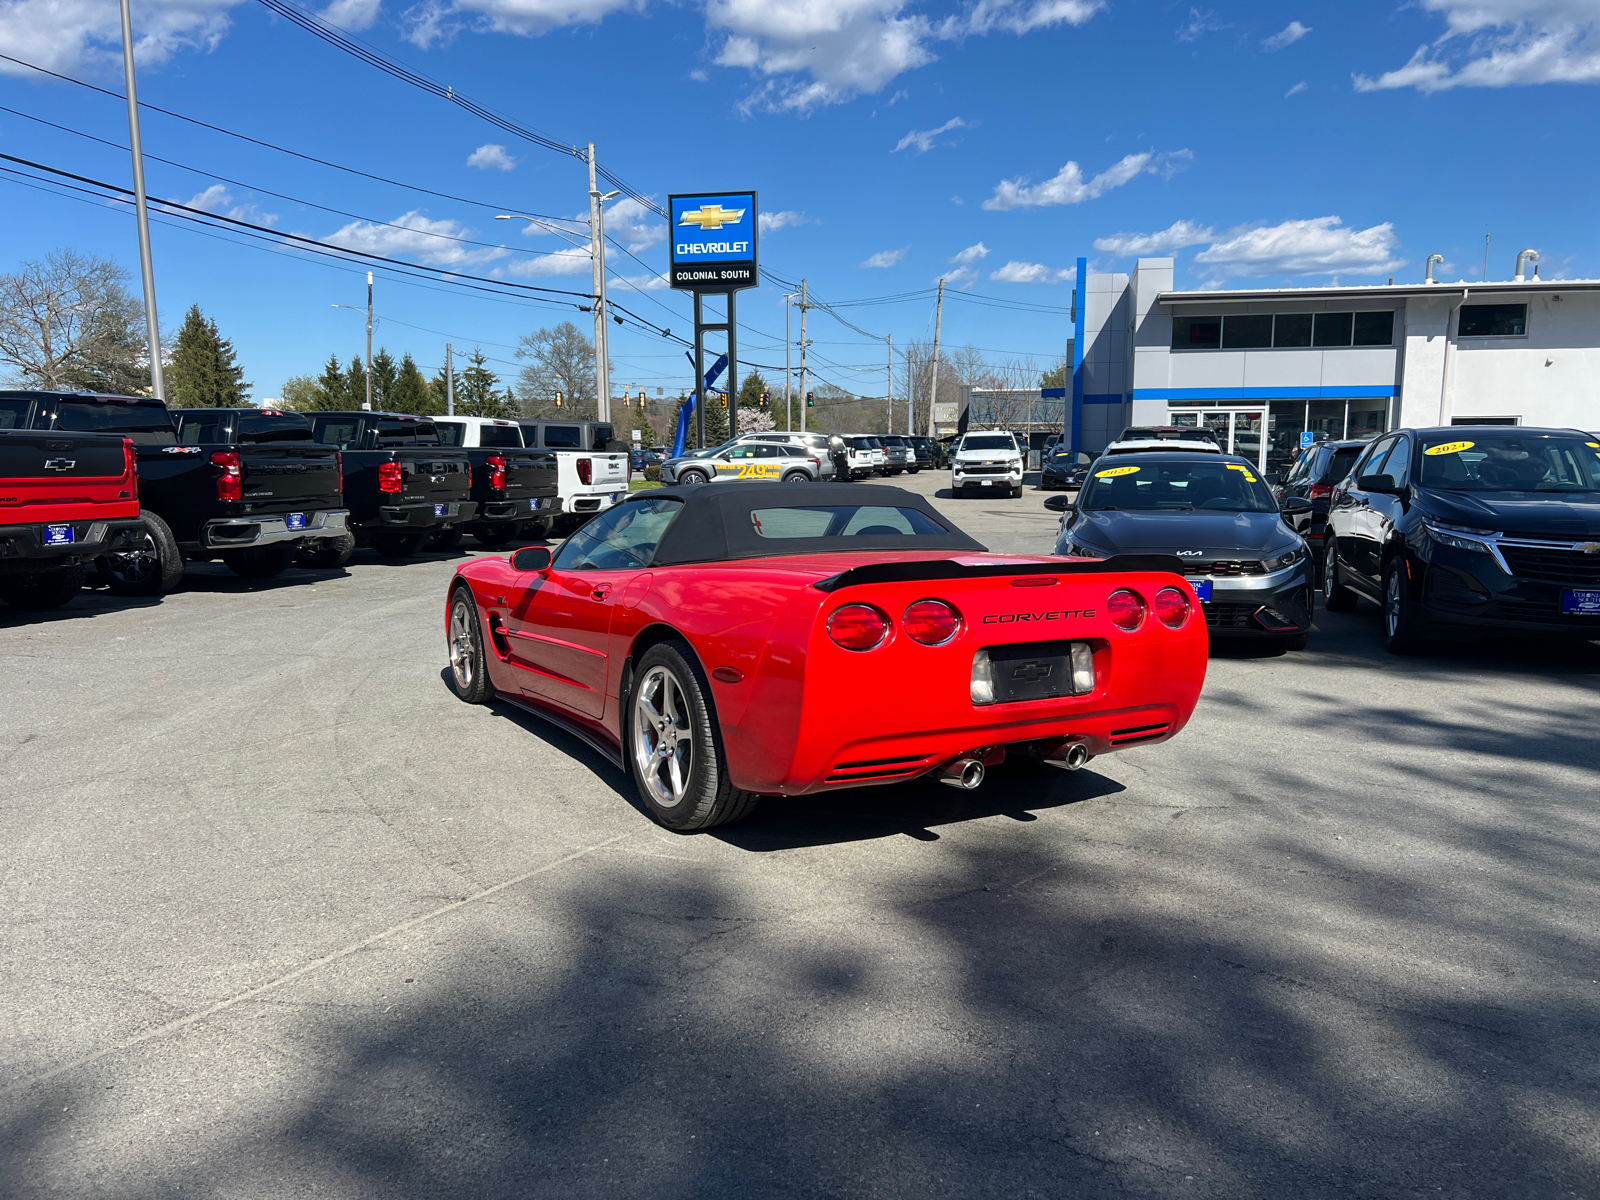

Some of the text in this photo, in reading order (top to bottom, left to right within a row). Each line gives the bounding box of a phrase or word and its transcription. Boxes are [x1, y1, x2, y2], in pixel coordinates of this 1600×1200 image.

[676, 241, 749, 254] CHEVROLET
[676, 270, 750, 280] COLONIAL SOUTH
[1434, 442, 1466, 454] 2024
[982, 609, 1096, 624] CORVETTE
